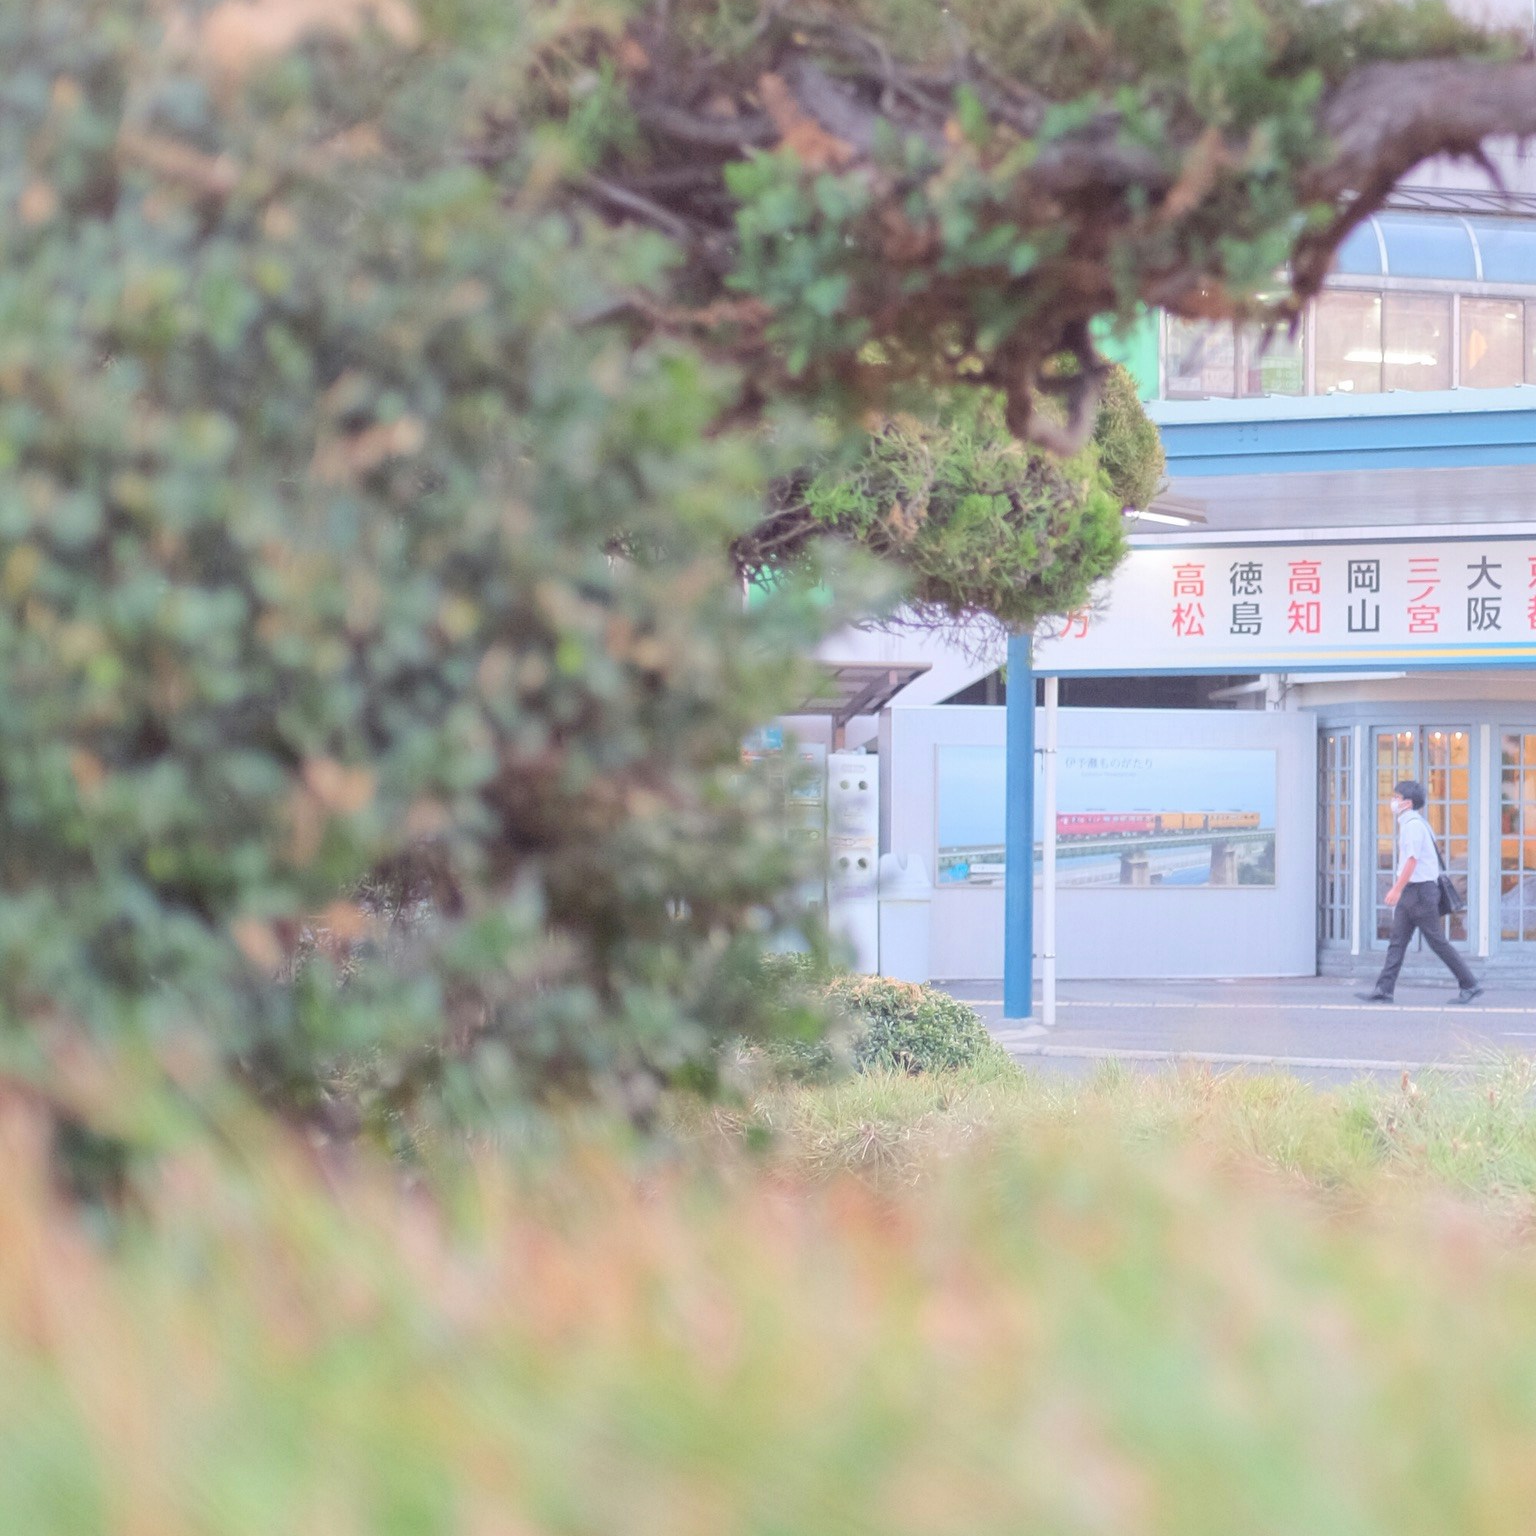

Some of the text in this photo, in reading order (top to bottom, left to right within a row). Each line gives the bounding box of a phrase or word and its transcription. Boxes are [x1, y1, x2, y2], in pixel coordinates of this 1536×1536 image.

[1172, 562, 1205, 637] 高松
[1230, 561, 1263, 635] 徳島
[1288, 560, 1322, 634] 高知
[1348, 559, 1380, 633] 岡山
[1407, 557, 1441, 633] 三ノ宮
[1467, 555, 1502, 631] 大阪
